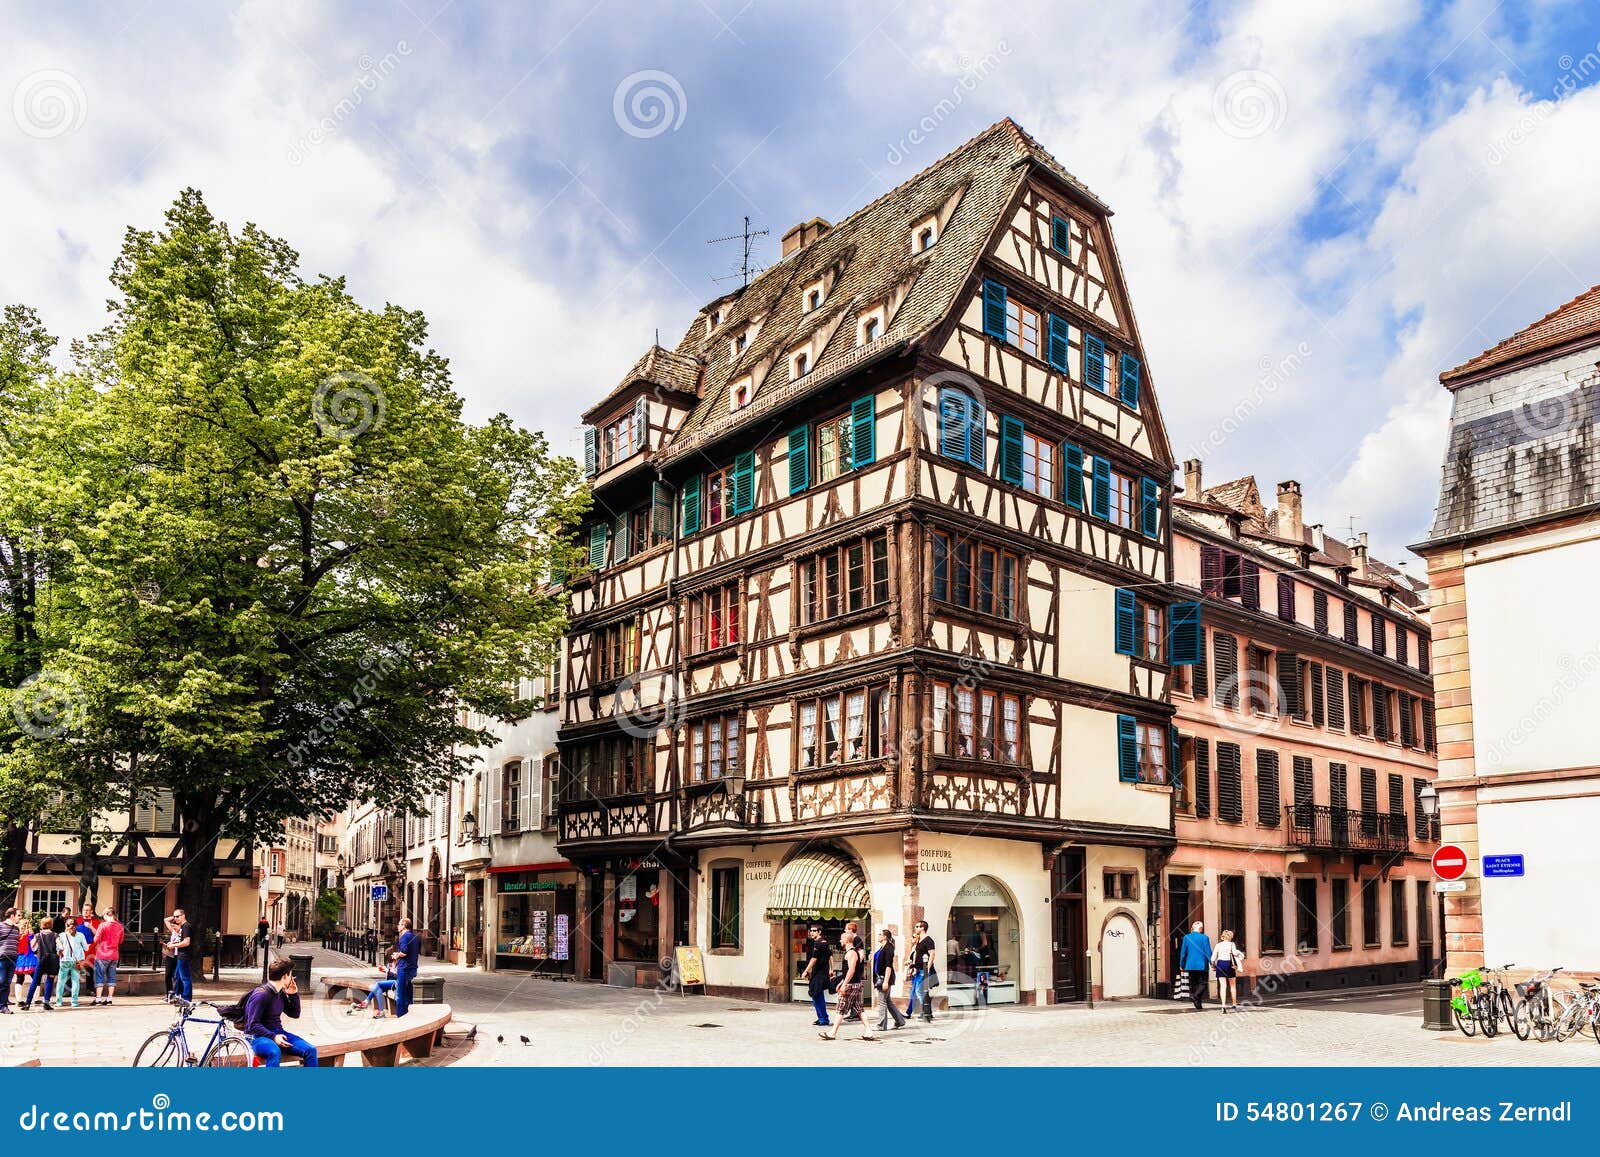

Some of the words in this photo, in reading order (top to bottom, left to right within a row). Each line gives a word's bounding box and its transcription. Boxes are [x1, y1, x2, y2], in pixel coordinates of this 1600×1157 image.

[920, 849, 952, 858] COIFFURE
[745, 861, 772, 869] COIFFURE
[920, 862, 952, 872] CLAUDE
[745, 872, 772, 880] CLAUDE
[791, 908, 821, 916] Christine
